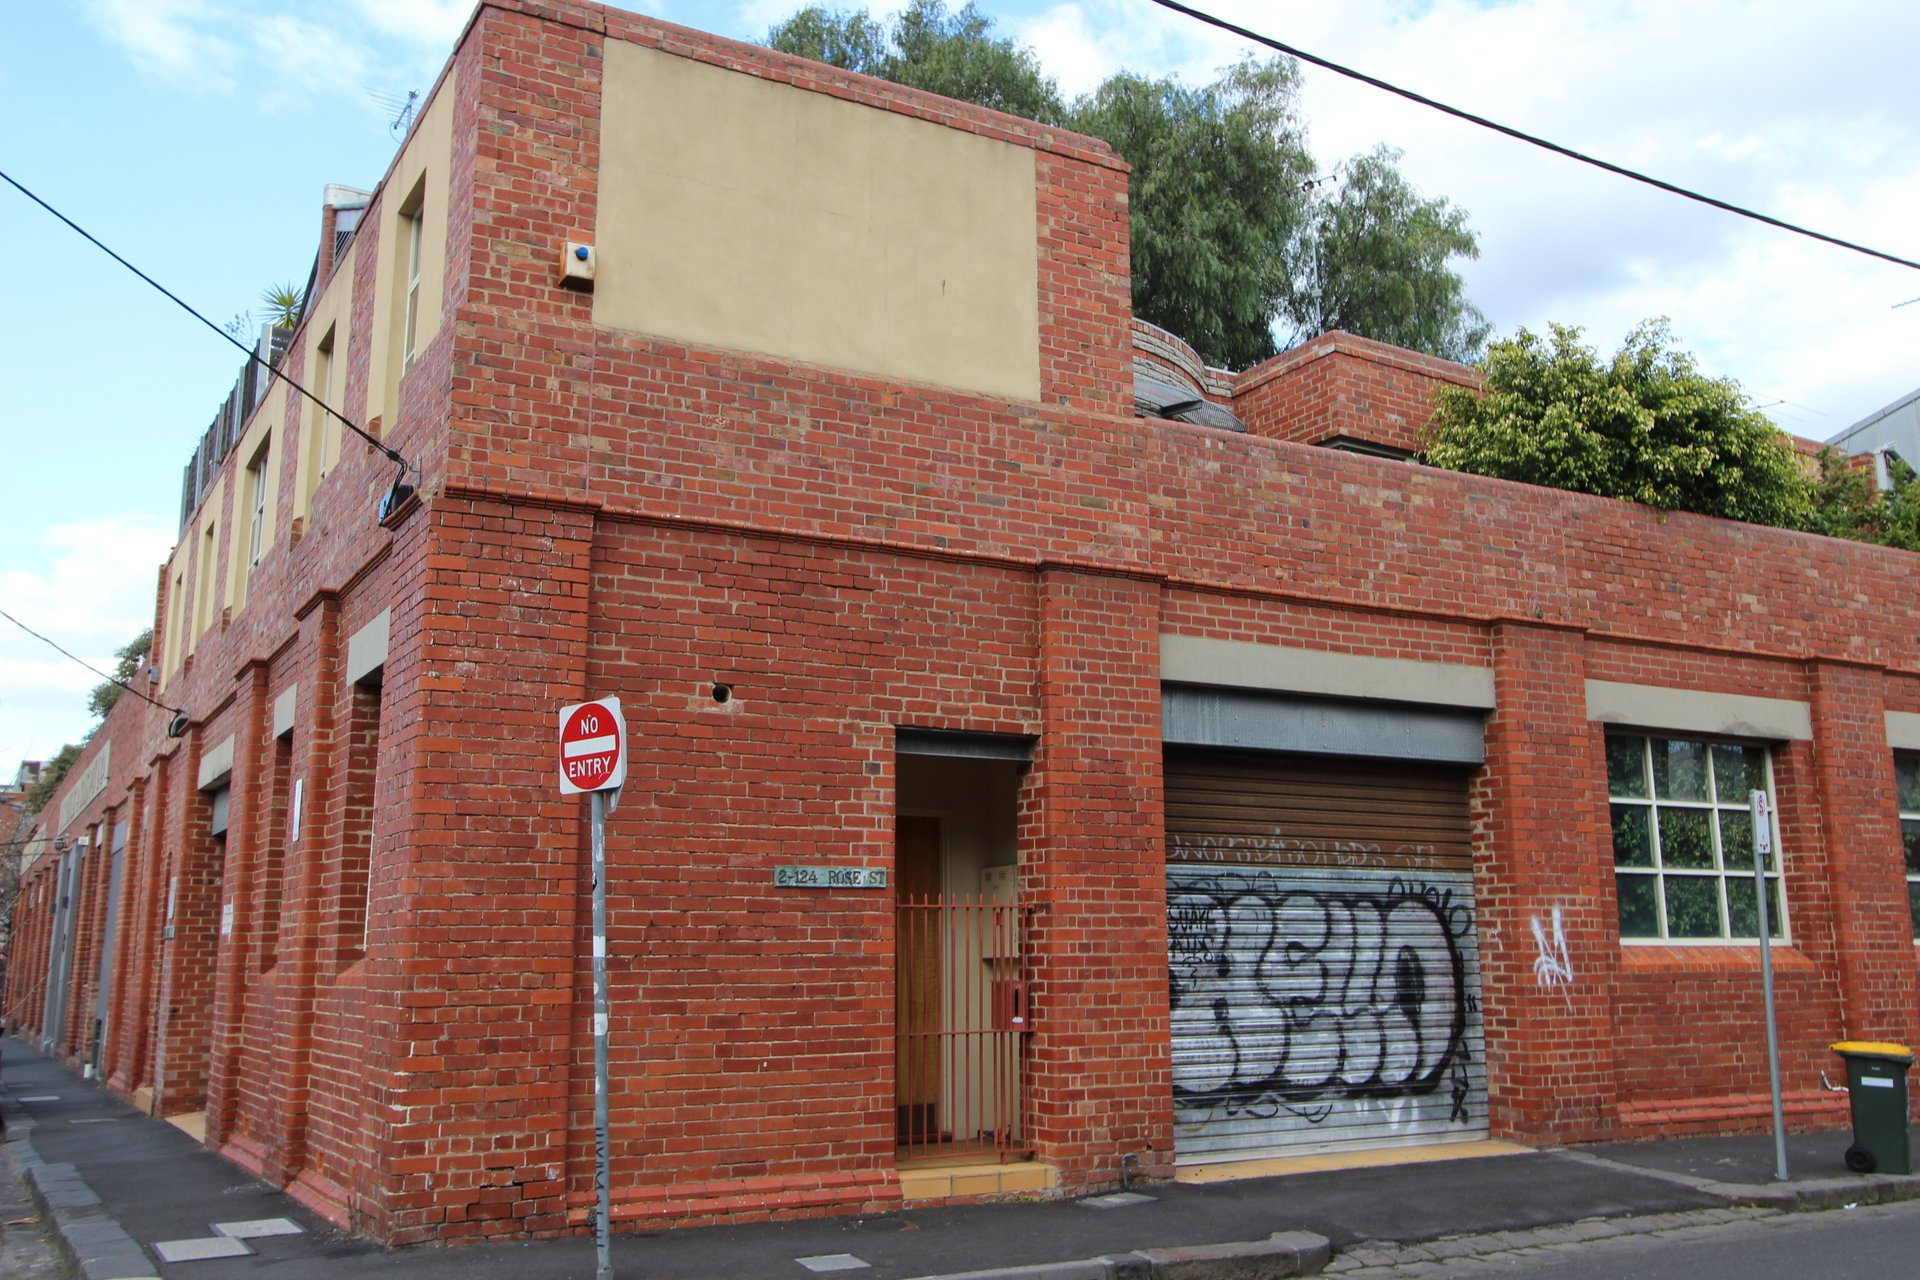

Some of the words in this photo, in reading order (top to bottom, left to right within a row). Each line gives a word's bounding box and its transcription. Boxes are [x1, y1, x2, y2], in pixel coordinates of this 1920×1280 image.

[581, 716, 599, 736] NO
[569, 755, 612, 779] ENTRY
[777, 869, 819, 885] 2-124
[828, 870, 862, 886] ROSE
[869, 870, 886, 886] ST
